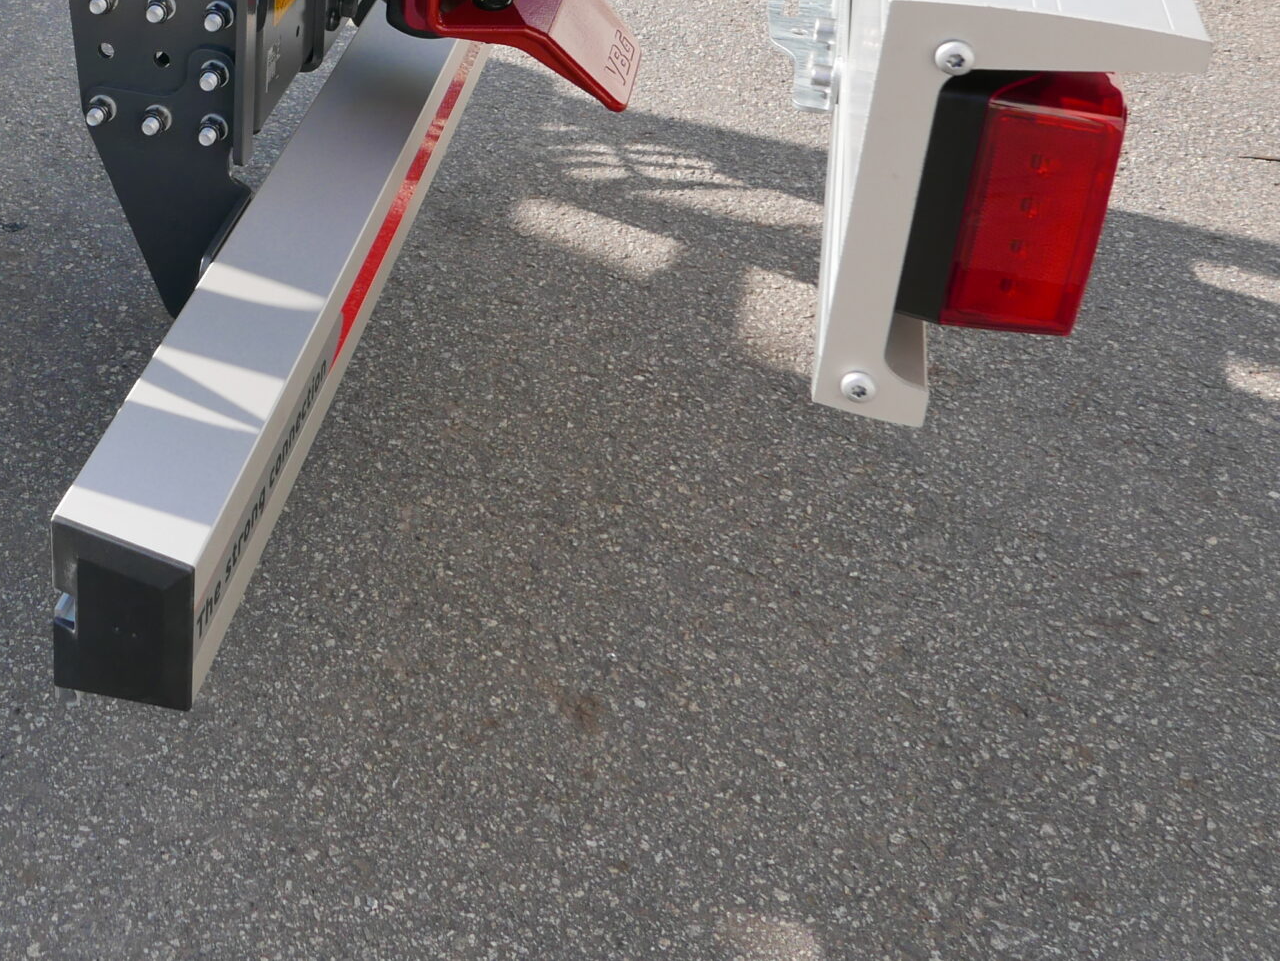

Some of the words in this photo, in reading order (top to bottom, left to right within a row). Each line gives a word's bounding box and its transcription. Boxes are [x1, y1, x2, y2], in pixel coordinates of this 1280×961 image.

[604, 29, 635, 86] VBG
[196, 579, 222, 640] The
[224, 485, 266, 582] strong
[269, 359, 327, 489] connection
